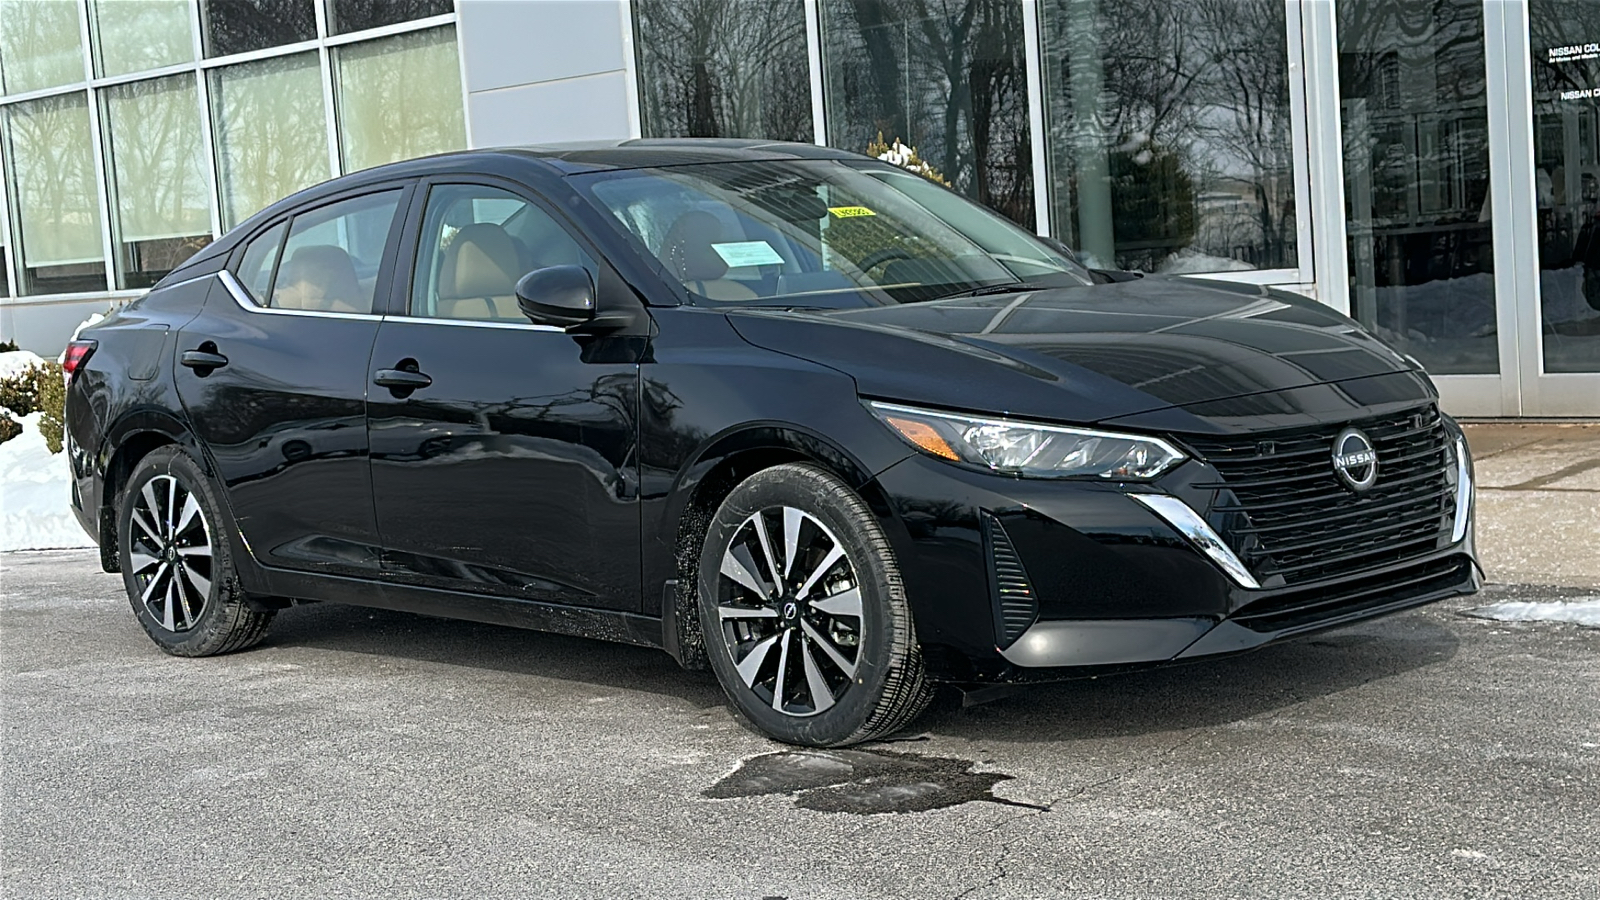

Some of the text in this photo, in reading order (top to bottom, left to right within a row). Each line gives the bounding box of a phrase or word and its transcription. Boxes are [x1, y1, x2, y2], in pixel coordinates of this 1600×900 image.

[1549, 45, 1582, 57] NISSAN
[1561, 89, 1592, 100] NISSAN
[1336, 451, 1376, 467] NISSAN
